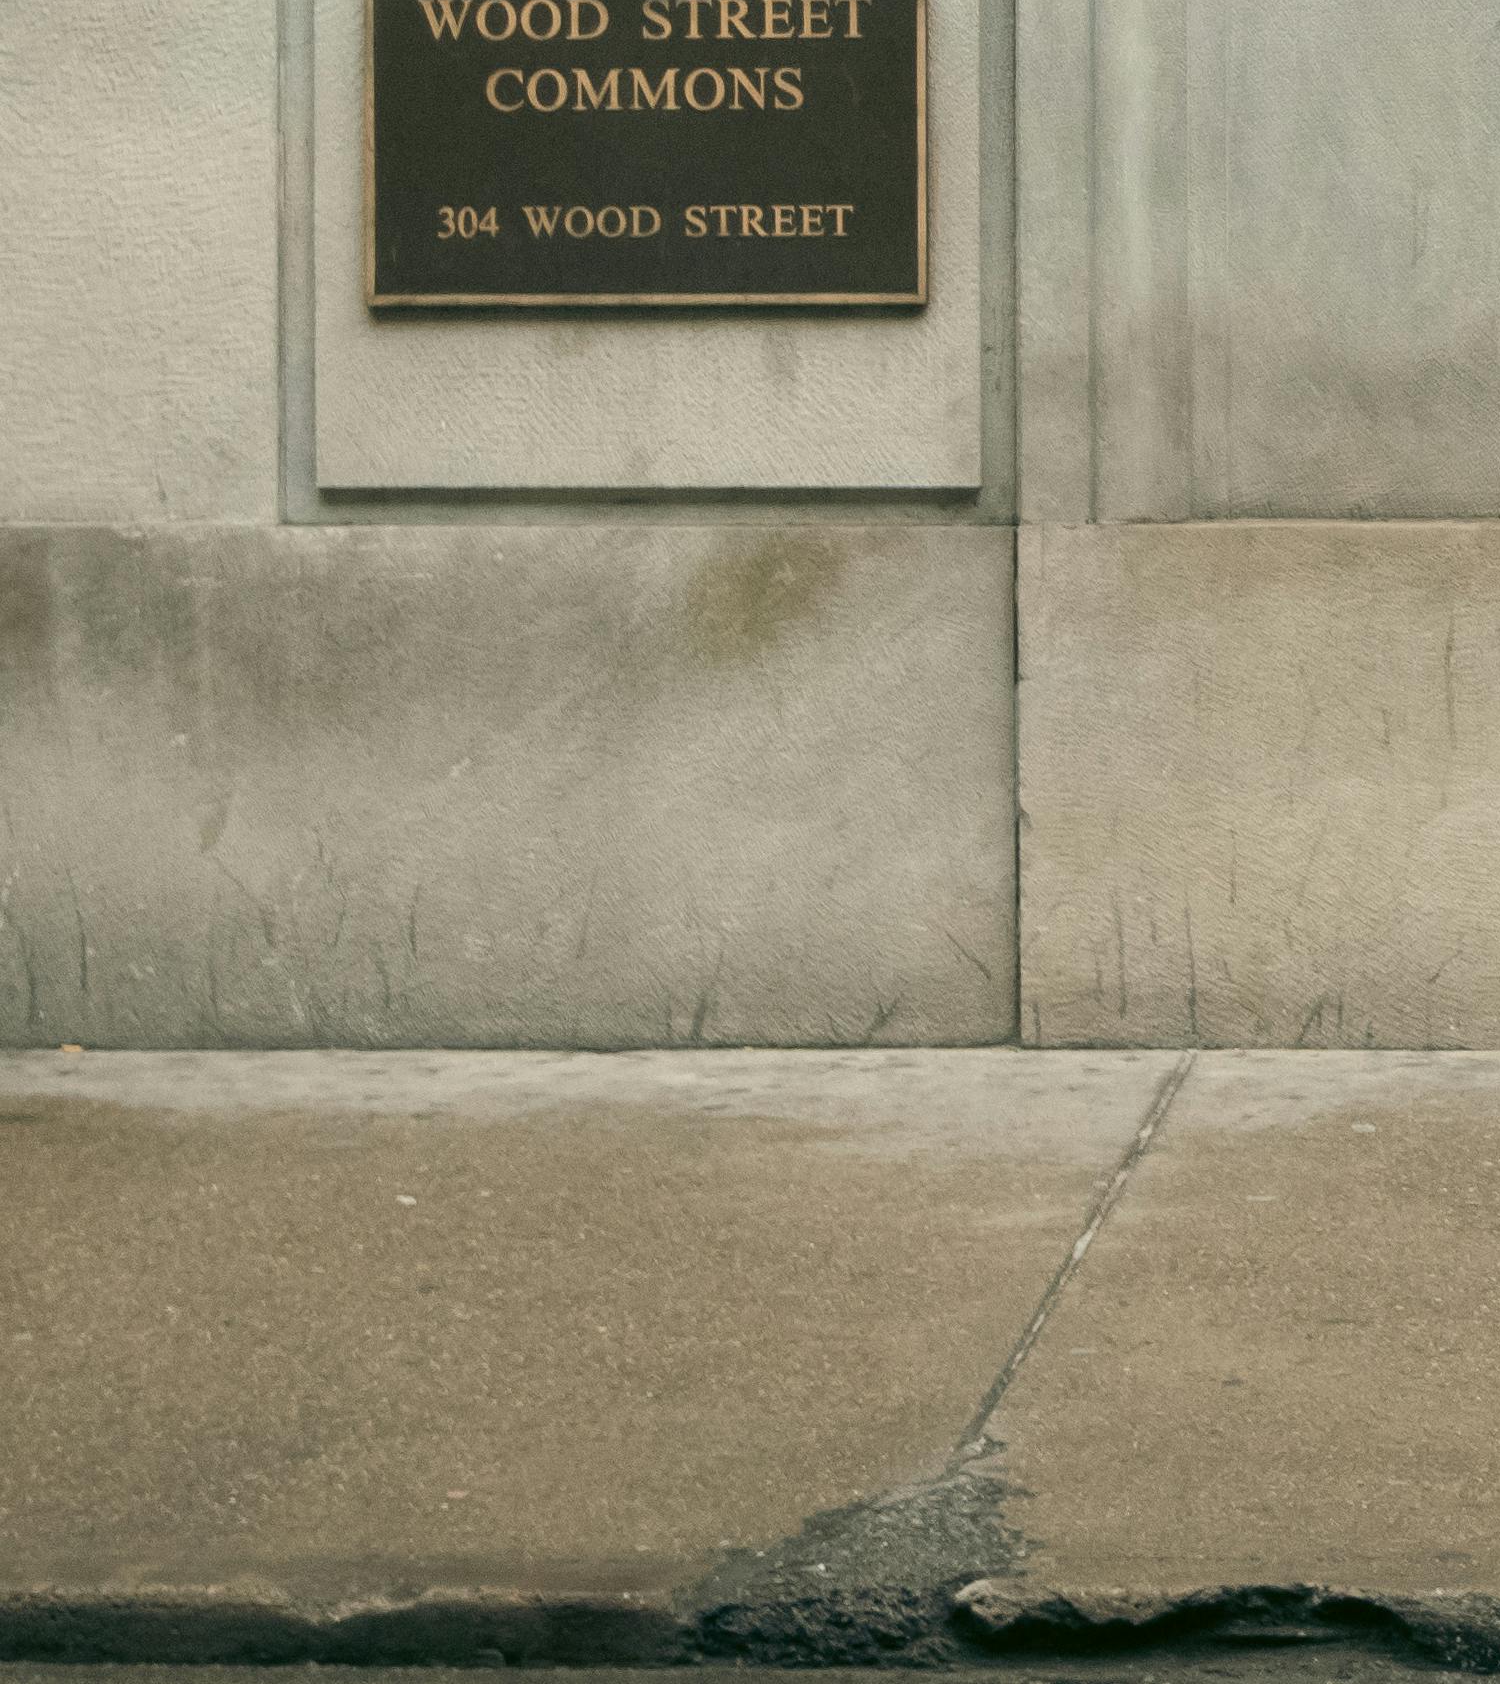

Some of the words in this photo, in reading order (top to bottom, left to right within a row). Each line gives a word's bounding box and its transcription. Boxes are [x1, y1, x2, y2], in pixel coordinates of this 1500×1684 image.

[486, 68, 805, 112] COMMONS
[438, 207, 499, 239] 304
[522, 206, 662, 238] WOOD
[685, 204, 854, 238] STREET
